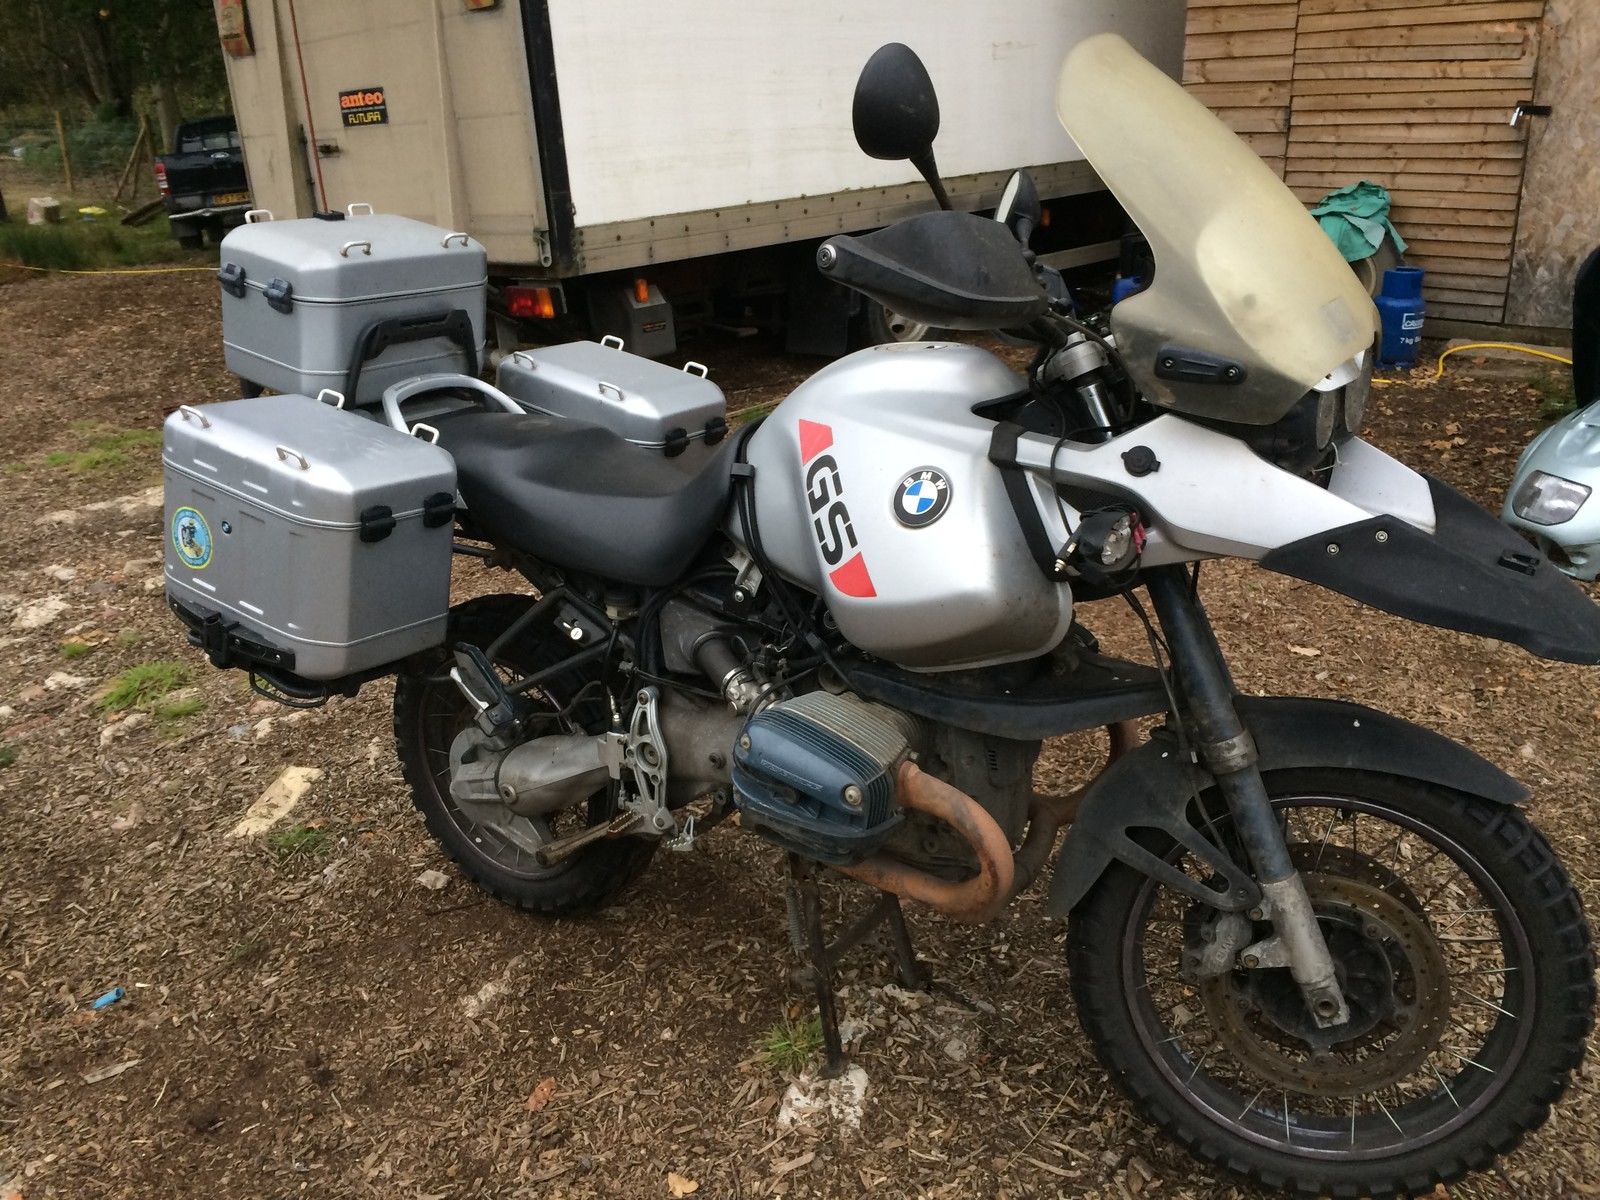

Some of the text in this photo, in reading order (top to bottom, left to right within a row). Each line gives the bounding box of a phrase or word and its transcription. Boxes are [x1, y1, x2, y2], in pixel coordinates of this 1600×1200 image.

[341, 92, 383, 108] anteo
[348, 111, 381, 124] FUTURA
[903, 471, 947, 490] BMW
[806, 454, 859, 566] GS
